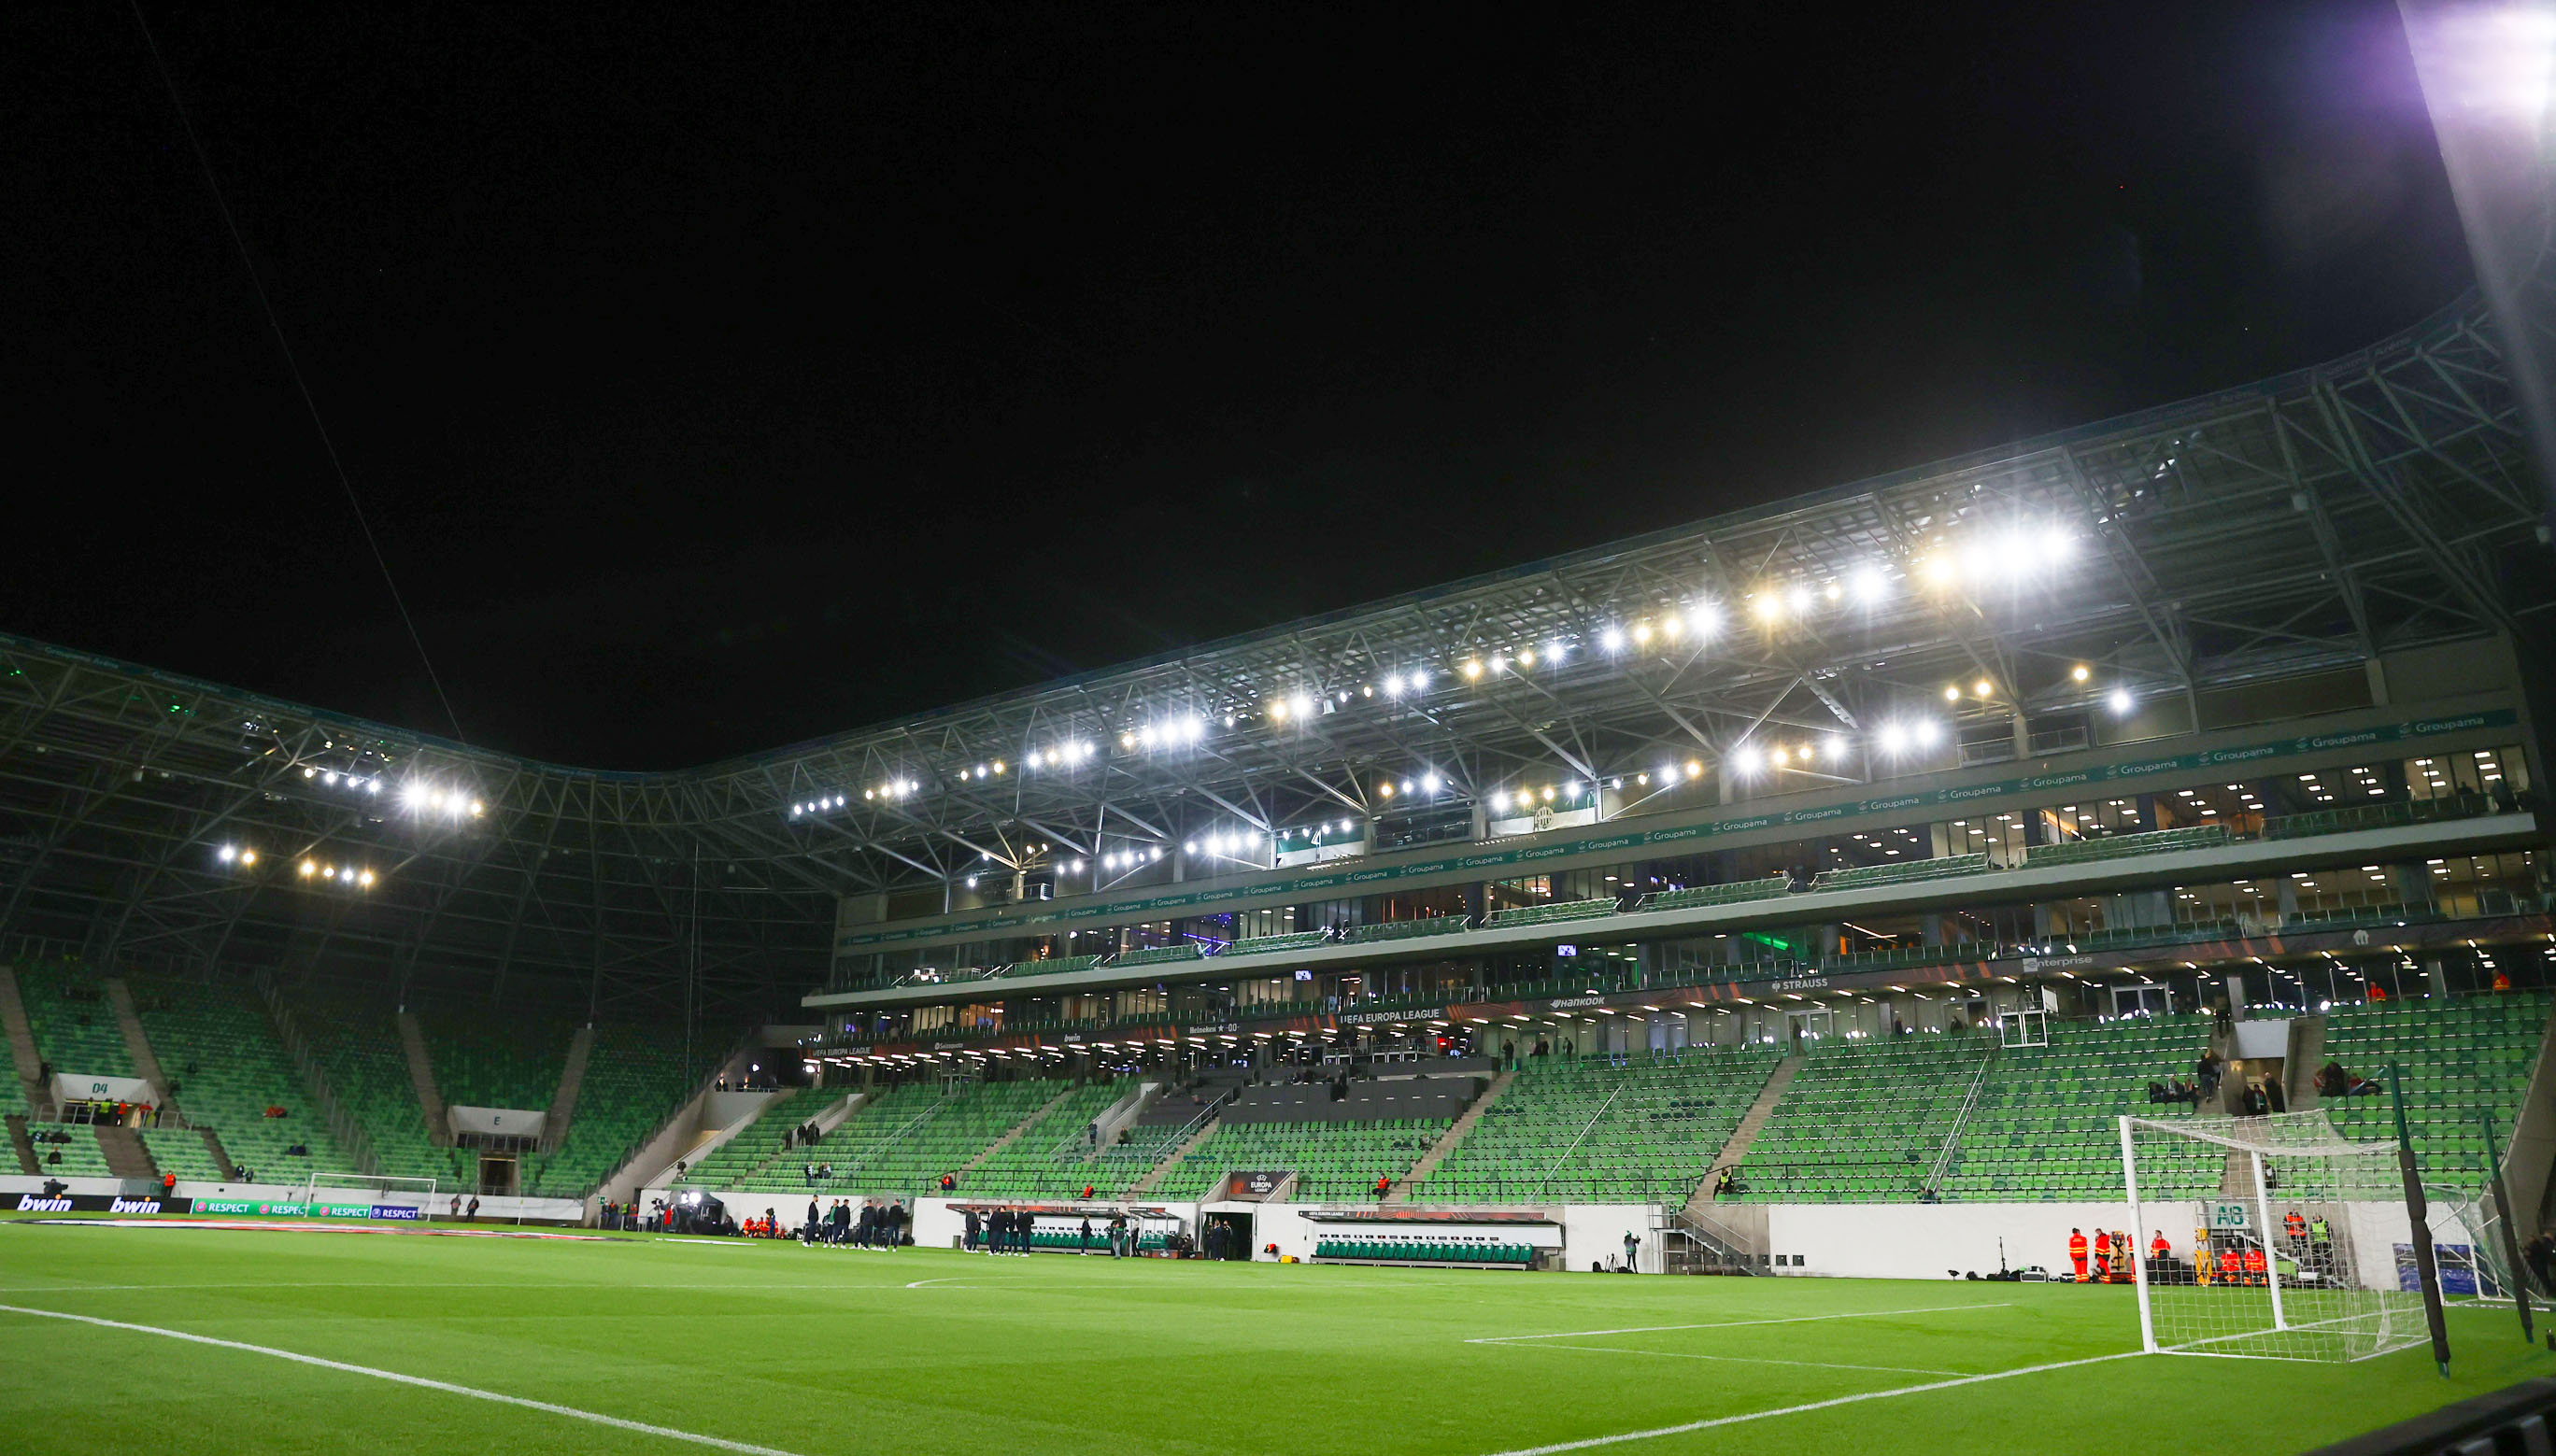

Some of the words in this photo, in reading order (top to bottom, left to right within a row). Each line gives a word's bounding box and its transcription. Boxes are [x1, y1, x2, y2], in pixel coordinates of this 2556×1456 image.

[2415, 716, 2484, 733] Groupama
[2312, 732, 2376, 747] Groupama
[2214, 747, 2274, 762] Groupama
[2121, 760, 2177, 775] Groupama
[2033, 773, 2087, 787] Groupama
[1950, 785, 2001, 799] Groupama
[1870, 798, 1919, 811] Groupama
[1795, 808, 1841, 821] Groupama
[1723, 818, 1768, 831] Groupama
[1654, 828, 1697, 841] Groupama
[1588, 839, 1628, 851] Groupama
[1526, 847, 1564, 859] Groupama
[1466, 855, 1502, 867] Groupama
[1408, 863, 1443, 874] Groupama
[1354, 870, 1387, 882] Groupama
[1300, 878, 1333, 888] Groupama
[1203, 891, 1233, 900] Groupama
[1250, 884, 1282, 895] Groupama
[1157, 898, 1186, 906] Groupama
[2027, 956, 2093, 968] enterprise
[1782, 978, 1828, 990] STRAUSS
[1341, 1013, 1363, 1024] UEFA
[1366, 1011, 1400, 1022] EUROPA
[1403, 1009, 1440, 1020] LEAGUE
[1189, 1025, 1216, 1034] Heineken
[1064, 1033, 1081, 1042] bwin
[92, 1083, 108, 1094] D4
[493, 1116, 502, 1125] E
[17, 1194, 73, 1211] bwin
[109, 1196, 161, 1214] bwin
[208, 1203, 249, 1213] RESPECT
[331, 1207, 368, 1217] RESPECT
[382, 1209, 418, 1218] RESPECT
